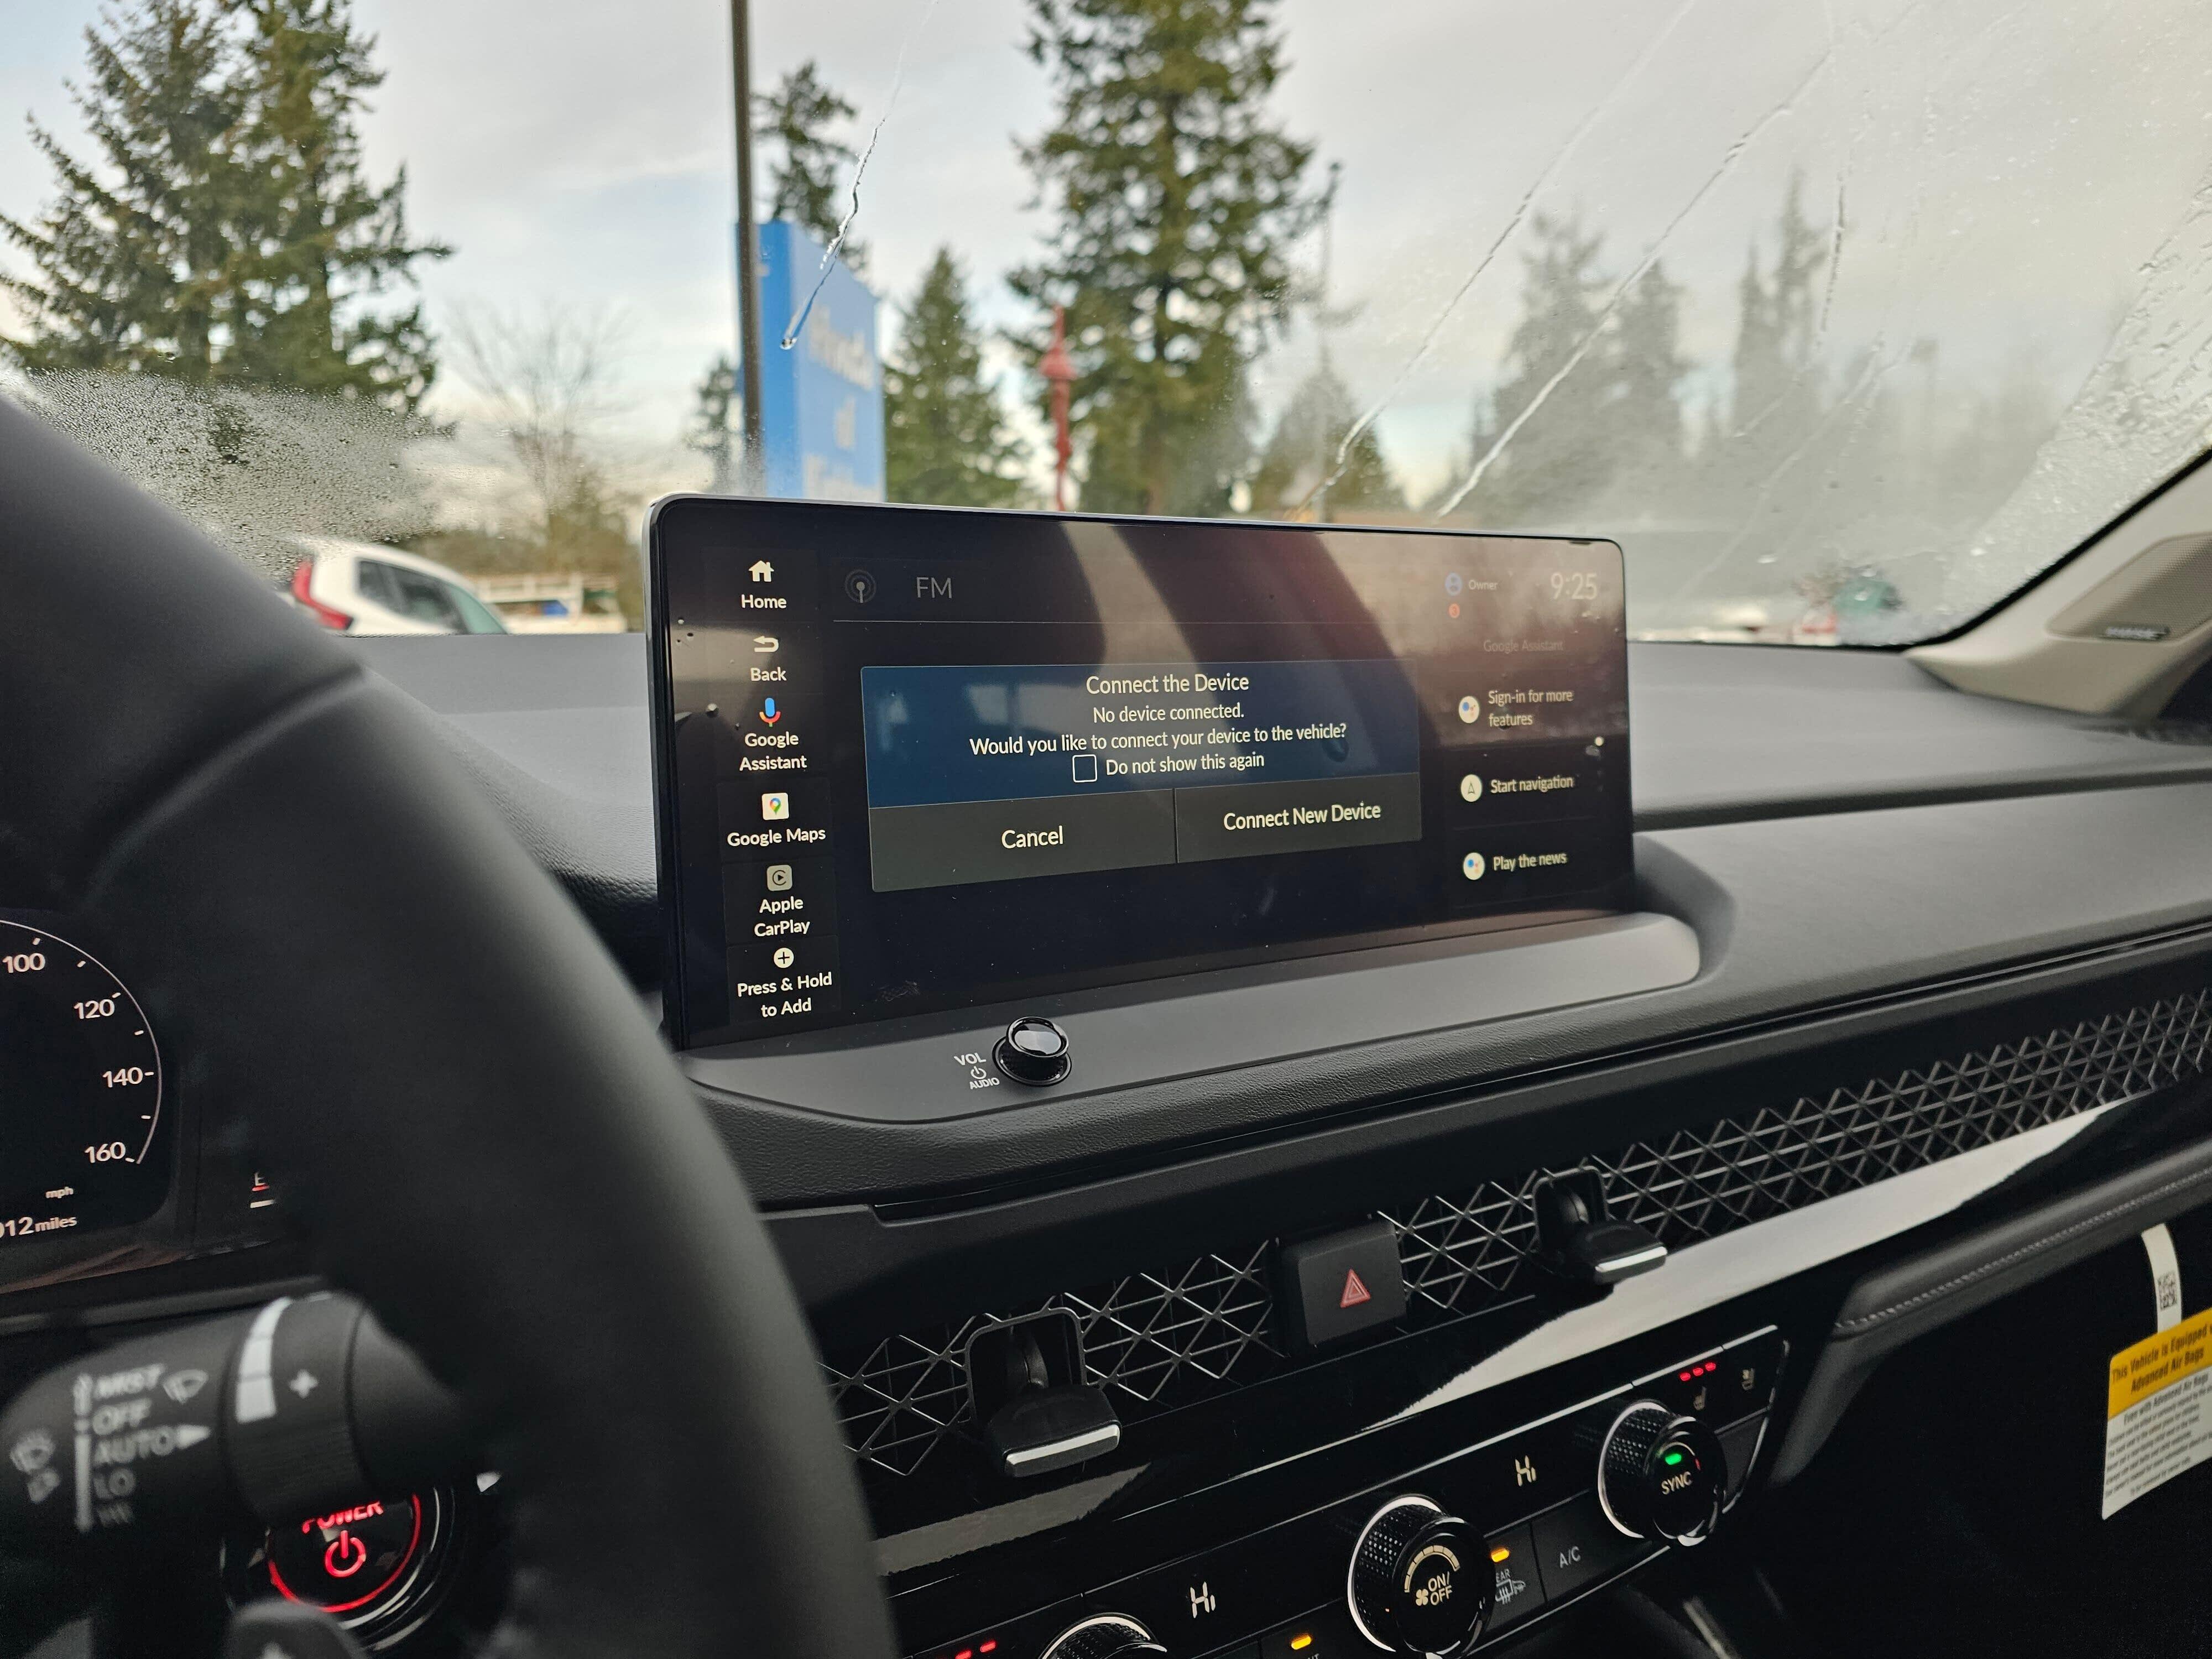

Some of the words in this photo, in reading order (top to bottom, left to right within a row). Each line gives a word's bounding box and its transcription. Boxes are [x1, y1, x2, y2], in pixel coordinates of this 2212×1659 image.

[916, 576, 953, 599] FM
[1468, 580, 1499, 591] Owner
[1550, 572, 1598, 600] 9:25
[741, 594, 787, 609] Home
[1483, 640, 1519, 654] Google
[1521, 639, 1564, 652] Assistant
[750, 667, 787, 681] Back
[1086, 675, 1159, 695] Connect
[1162, 674, 1190, 692] the
[1194, 672, 1249, 691] Device
[1488, 690, 1526, 707] Sign-in
[1528, 689, 1544, 703] for
[1546, 690, 1574, 703] more
[1093, 707, 1115, 724] No
[1119, 704, 1166, 722] device
[1169, 702, 1244, 721] connected.
[1489, 712, 1533, 727] features
[744, 731, 799, 749] Google
[969, 735, 1024, 755] Would
[1026, 738, 1057, 756] you
[1061, 734, 1087, 752] like
[1091, 735, 1107, 750] to
[1110, 731, 1169, 749] connect
[1171, 732, 1204, 748] your
[1207, 727, 1251, 745] device
[1254, 728, 1269, 743] to
[1271, 725, 1293, 742] the
[1296, 723, 1347, 740] vehicle?
[739, 755, 807, 771] Assistant
[1106, 759, 1129, 776] Do
[1132, 757, 1156, 774] not
[1159, 754, 1197, 773] show
[1200, 753, 1226, 771] this
[1229, 752, 1265, 770] again
[1490, 779, 1517, 794] Start
[1519, 775, 1574, 792] navigation
[1223, 810, 1290, 831] Connect
[1292, 805, 1328, 826] New
[1331, 801, 1381, 822] Device
[727, 830, 782, 848] Google
[786, 827, 826, 844] Maps
[1001, 826, 1064, 849] Cancel
[1493, 855, 1516, 872] Play
[1518, 854, 1536, 869] the
[1539, 852, 1567, 867] news
[759, 895, 804, 915] Apple
[754, 918, 811, 937] CarPlay
[2, 953, 45, 973] 100
[737, 980, 776, 997] Press
[780, 977, 793, 992] &
[797, 972, 833, 989] Hold
[74, 999, 115, 1019] 120
[761, 1004, 777, 1018] to
[780, 997, 812, 1015] Add
[953, 1052, 987, 1066] VOL
[102, 1067, 143, 1087] 140
[969, 1077, 1000, 1090] AUDIO
[84, 1142, 126, 1164] 160
[45, 1186, 74, 1199] mph
[35, 1217, 78, 1232] miles
[94, 1425, 177, 1465] AUTO
[1661, 1472, 1693, 1495] SYNC
[1559, 1546, 1581, 1569] A/C
[1496, 1568, 1511, 1582] EAR
[1430, 1585, 1453, 1605] OFF
